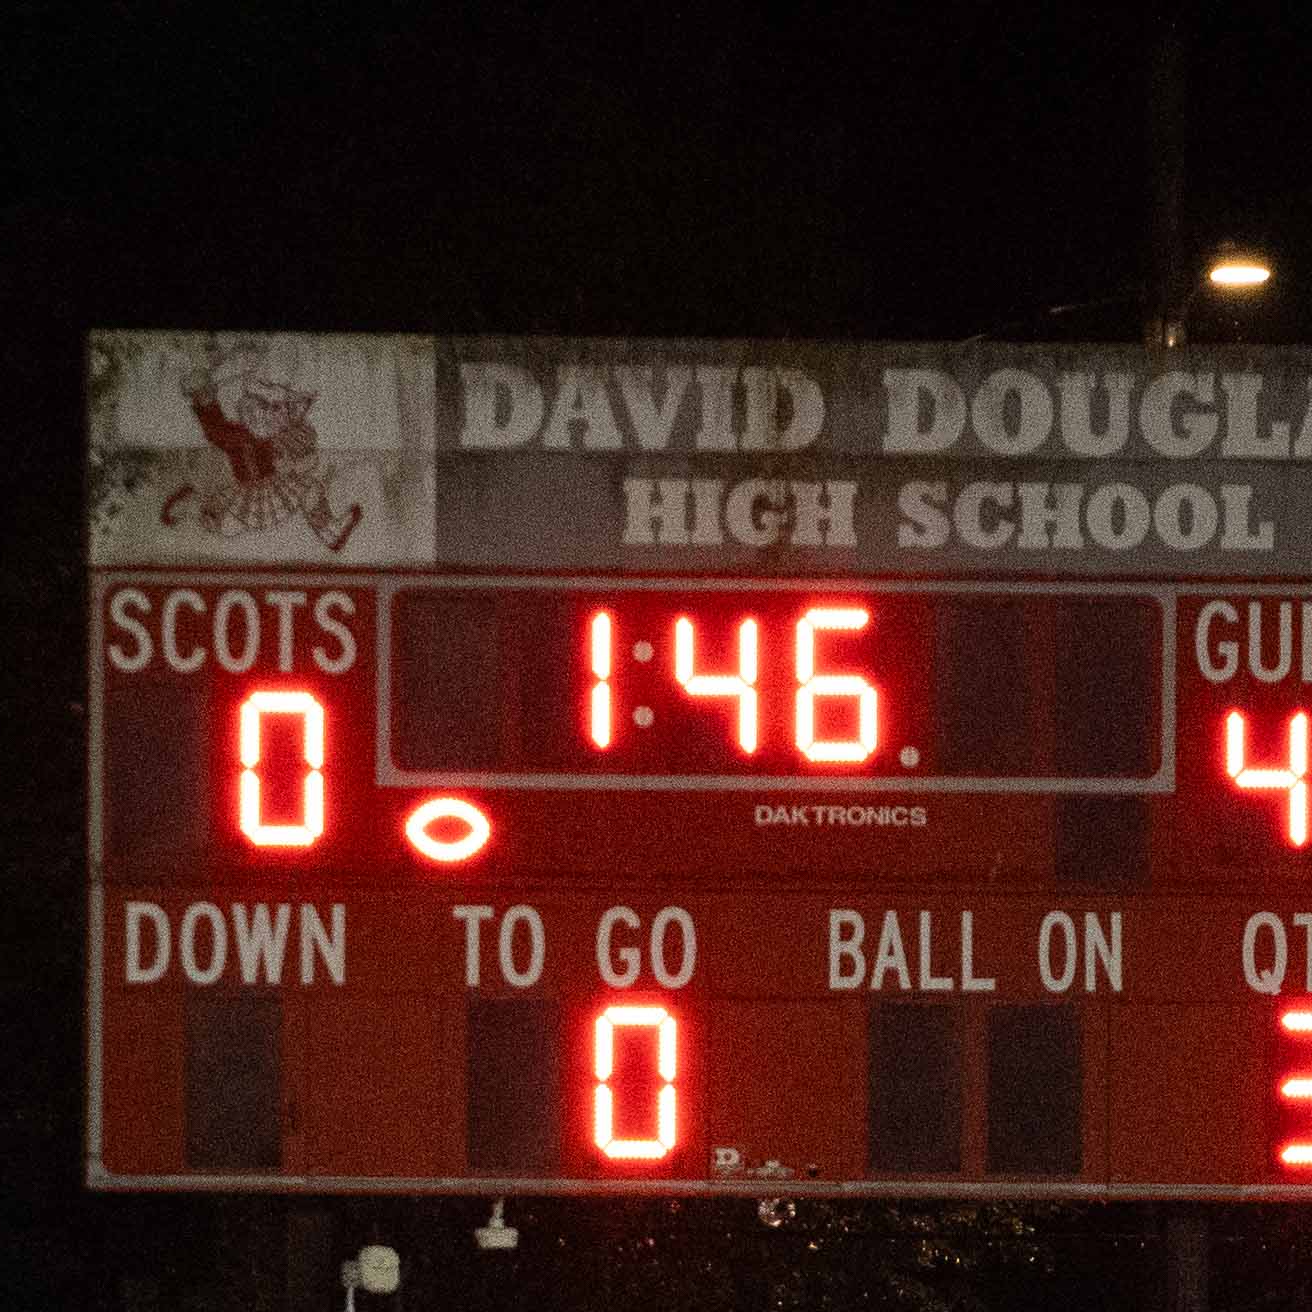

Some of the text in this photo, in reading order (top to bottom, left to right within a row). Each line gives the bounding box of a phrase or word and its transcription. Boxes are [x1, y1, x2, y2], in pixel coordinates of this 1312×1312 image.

[460, 363, 825, 452] DAVID
[622, 477, 1275, 551] HIGH SCHOOL
[108, 588, 358, 674] SCOTS
[239, 691, 325, 846] 0
[753, 804, 928, 827] DAKTRONICS
[124, 901, 348, 987] DOWN
[452, 905, 697, 990] TO GO
[828, 908, 1124, 993] BALL ON
[594, 1005, 677, 1160] 0
